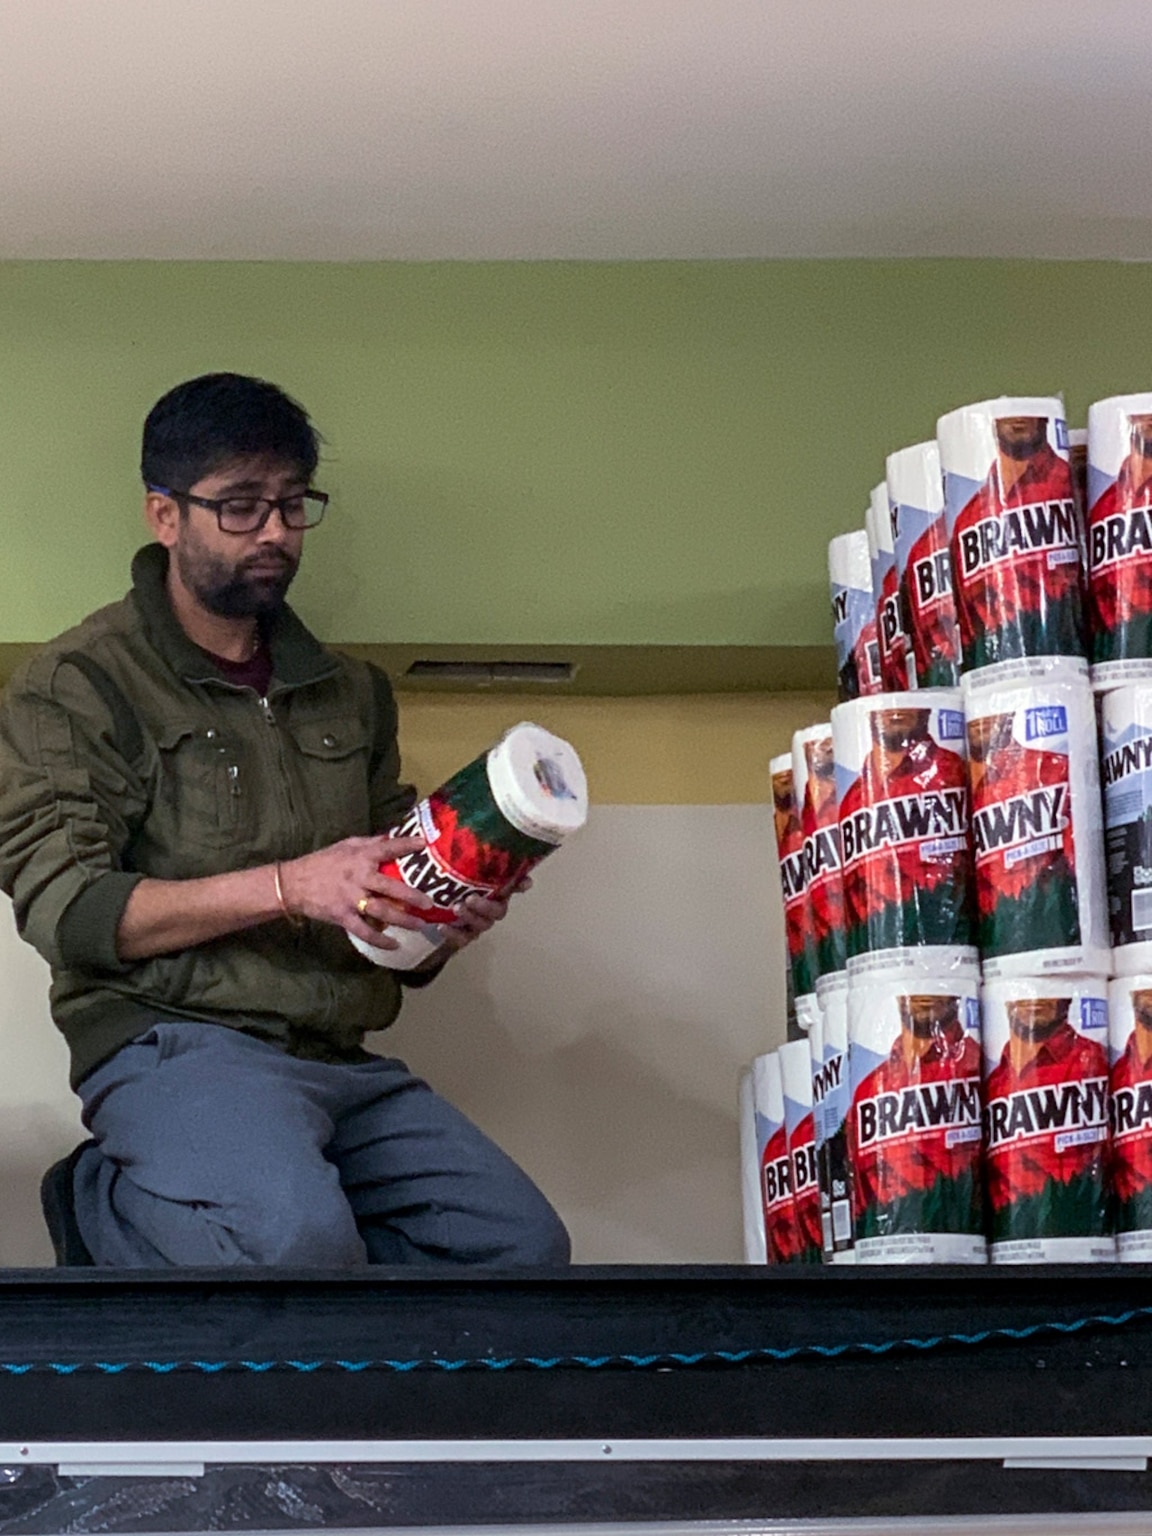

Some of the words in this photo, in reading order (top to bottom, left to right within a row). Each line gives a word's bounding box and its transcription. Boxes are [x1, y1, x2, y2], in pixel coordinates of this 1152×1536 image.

[960, 501, 1078, 576] BRAWN
[842, 790, 967, 865] BRAWNY
[859, 1081, 980, 1144] BRAWN
